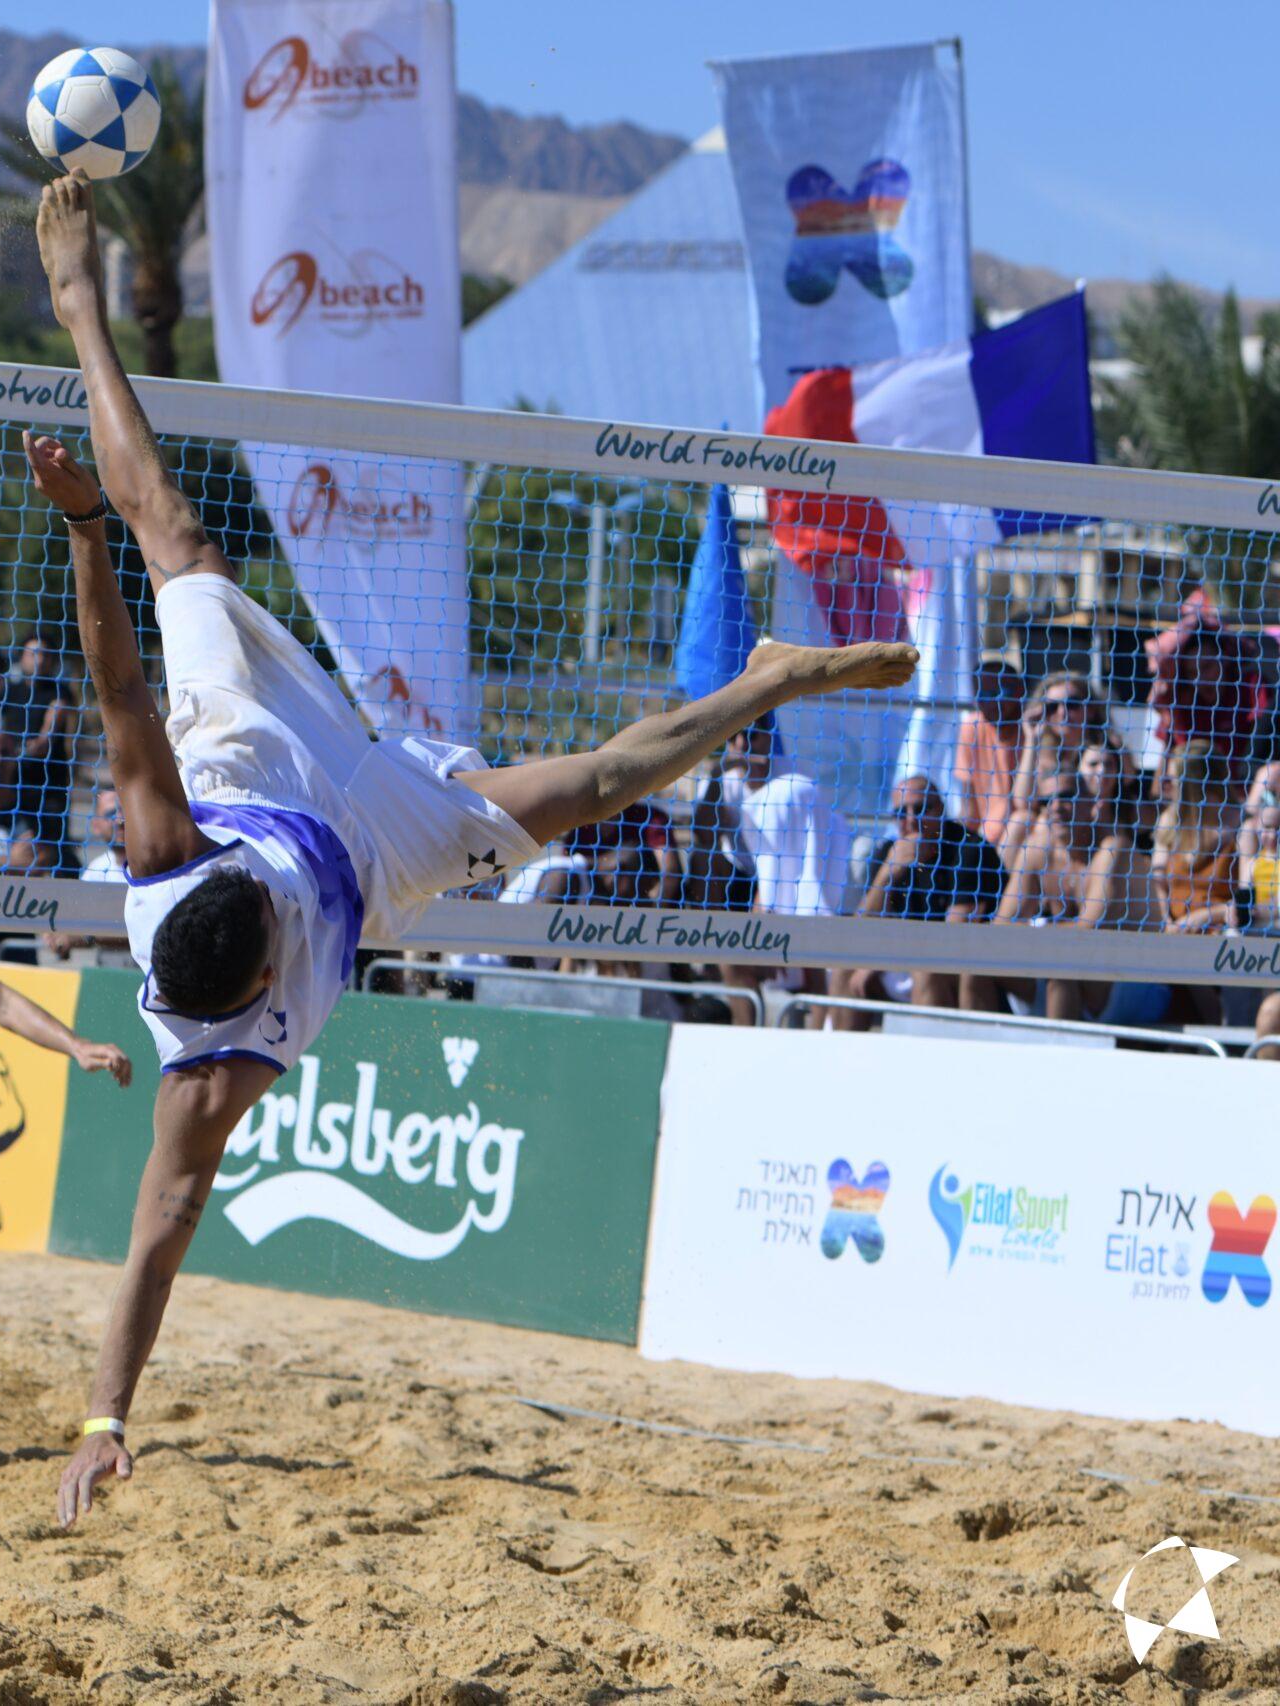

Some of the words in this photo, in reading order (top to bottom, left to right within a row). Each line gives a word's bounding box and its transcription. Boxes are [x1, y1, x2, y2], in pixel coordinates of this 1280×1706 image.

[595, 423, 696, 464] World
[702, 437, 837, 489] Footvolley
[547, 907, 649, 946] World
[656, 914, 792, 964] Footvolley
[1213, 938, 1280, 976] Worl
[211, 1054, 525, 1233] arlsberg
[1116, 1182, 1197, 1231] אילת
[762, 1218, 813, 1246] אילת
[1105, 1233, 1169, 1277] Eilat
